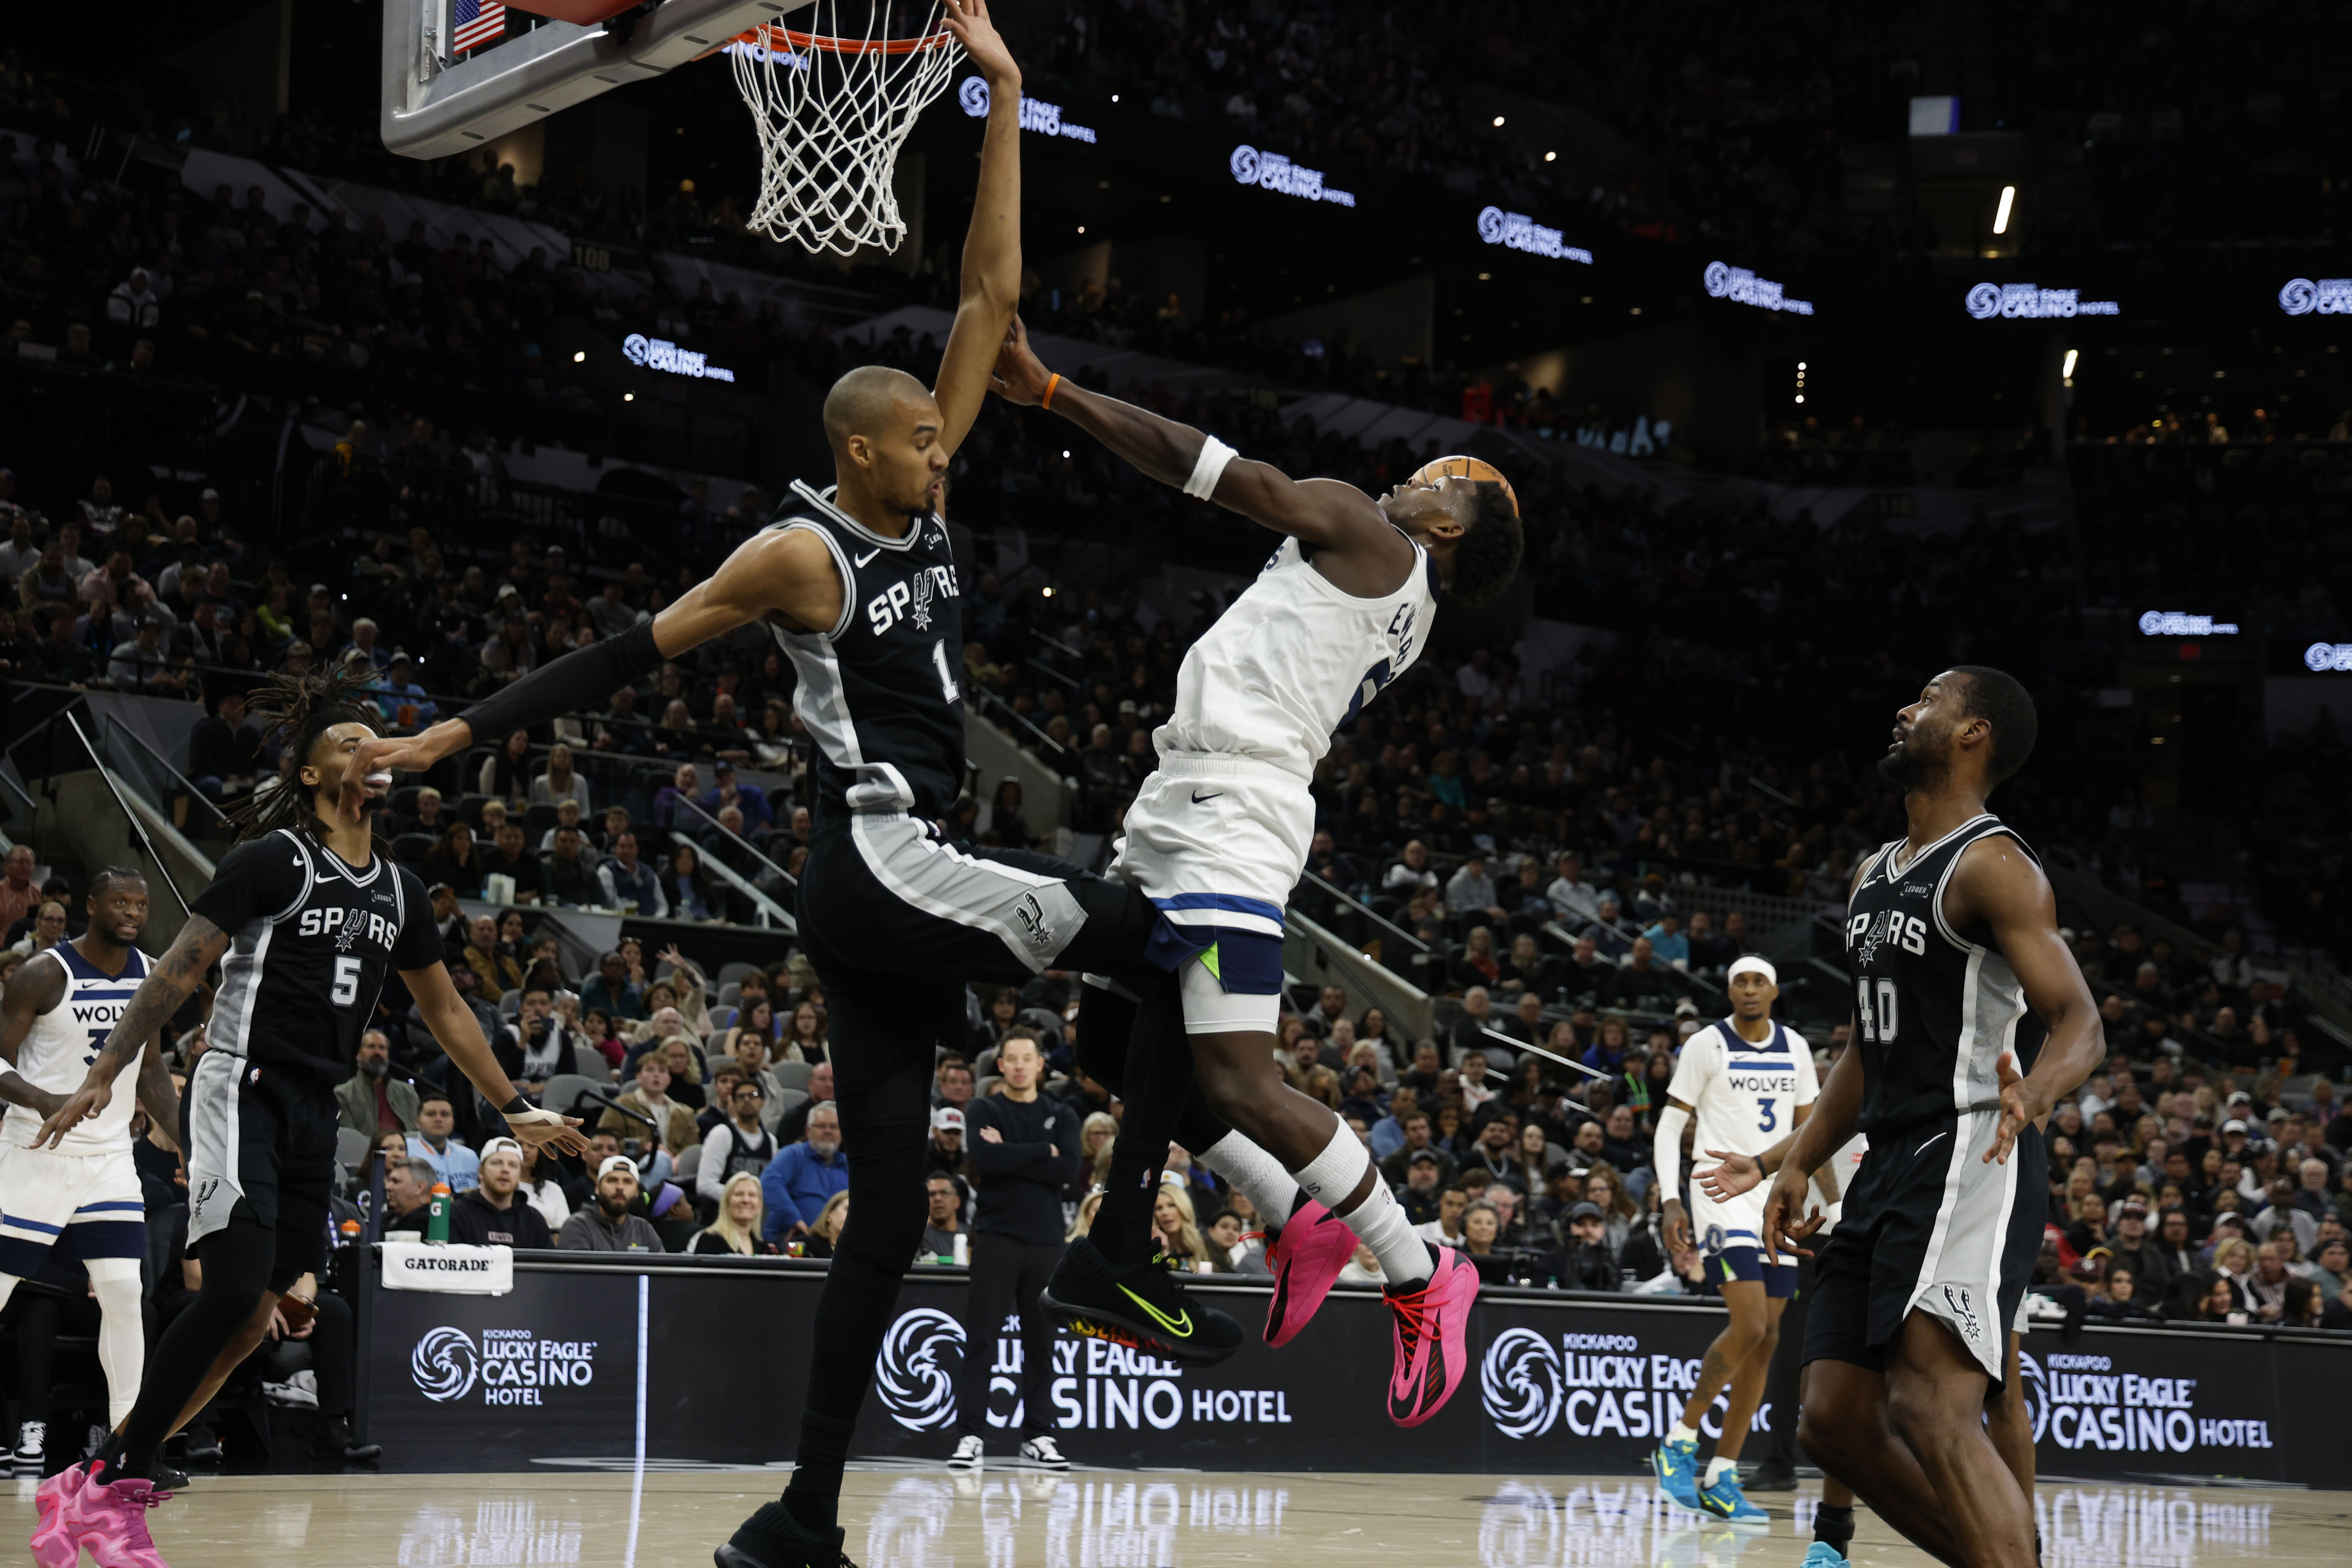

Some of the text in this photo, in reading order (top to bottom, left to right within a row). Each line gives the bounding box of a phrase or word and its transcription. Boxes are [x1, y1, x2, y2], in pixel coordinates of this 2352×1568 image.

[932, 638, 960, 705] 1
[374, 893, 392, 903] LEDGER
[1905, 884, 1928, 894] LEDGER
[299, 907, 398, 952] SPURS
[1846, 909, 1927, 969] PURS
[330, 955, 362, 1007] 5
[1858, 976, 1899, 1044] 40
[1757, 1098, 1777, 1132] 3
[430, 1202, 442, 1217] G
[405, 1258, 490, 1272] GATORADE
[482, 1329, 532, 1340] KICKAPOO
[483, 1340, 594, 1360] LUCKY EAGLE
[1564, 1333, 1637, 1352] KICKAPOO
[481, 1359, 593, 1387] CASINO
[1566, 1352, 1731, 1391] LUCKY EAG
[2047, 1353, 2112, 1372] KICKAPOO
[485, 1388, 544, 1405] HOTEL
[986, 1376, 1292, 1430] CSINO HOTEL
[2049, 1371, 2193, 1409] LUCKY EAGLE
[2051, 1405, 2273, 1453] CASINO HOTEL
